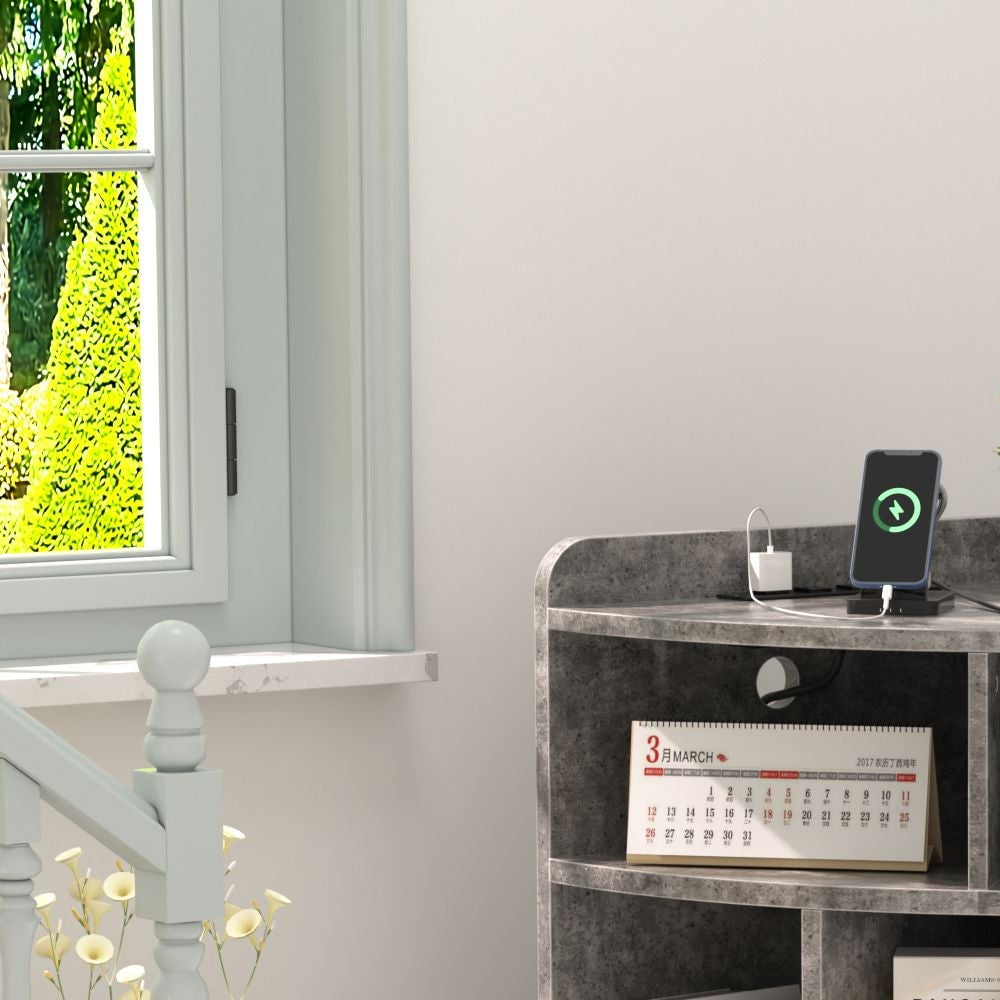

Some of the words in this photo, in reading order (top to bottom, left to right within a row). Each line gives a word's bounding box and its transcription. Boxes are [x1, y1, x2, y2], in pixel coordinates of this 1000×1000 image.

[857, 757, 874, 767] 2017
[709, 786, 713, 796] 1
[728, 786, 733, 797] 2
[747, 787, 752, 797] 3
[766, 787, 771, 797] 4
[786, 788, 791, 798] 5
[805, 788, 811, 798] 6
[825, 789, 830, 798] 7
[844, 789, 850, 799] 8
[863, 790, 869, 799] 9
[881, 790, 891, 800] 10
[901, 790, 910, 800] 11
[647, 807, 657, 816] 12
[666, 807, 676, 817] 13
[686, 807, 695, 817] 14
[705, 808, 715, 817] 15
[724, 808, 734, 818] 16
[744, 808, 753, 818] 17
[763, 809, 773, 819] 18
[783, 809, 792, 819] 19
[802, 810, 812, 820] 20
[821, 811, 831, 821] 21
[841, 811, 851, 821] 22
[860, 812, 870, 822] 23
[880, 812, 890, 822] 24
[899, 813, 909, 823] 25
[645, 828, 656, 838] 26
[665, 829, 675, 838] 27
[684, 829, 694, 839] 28
[703, 830, 714, 839] 29
[723, 830, 733, 840] 30
[743, 831, 752, 840] 31
